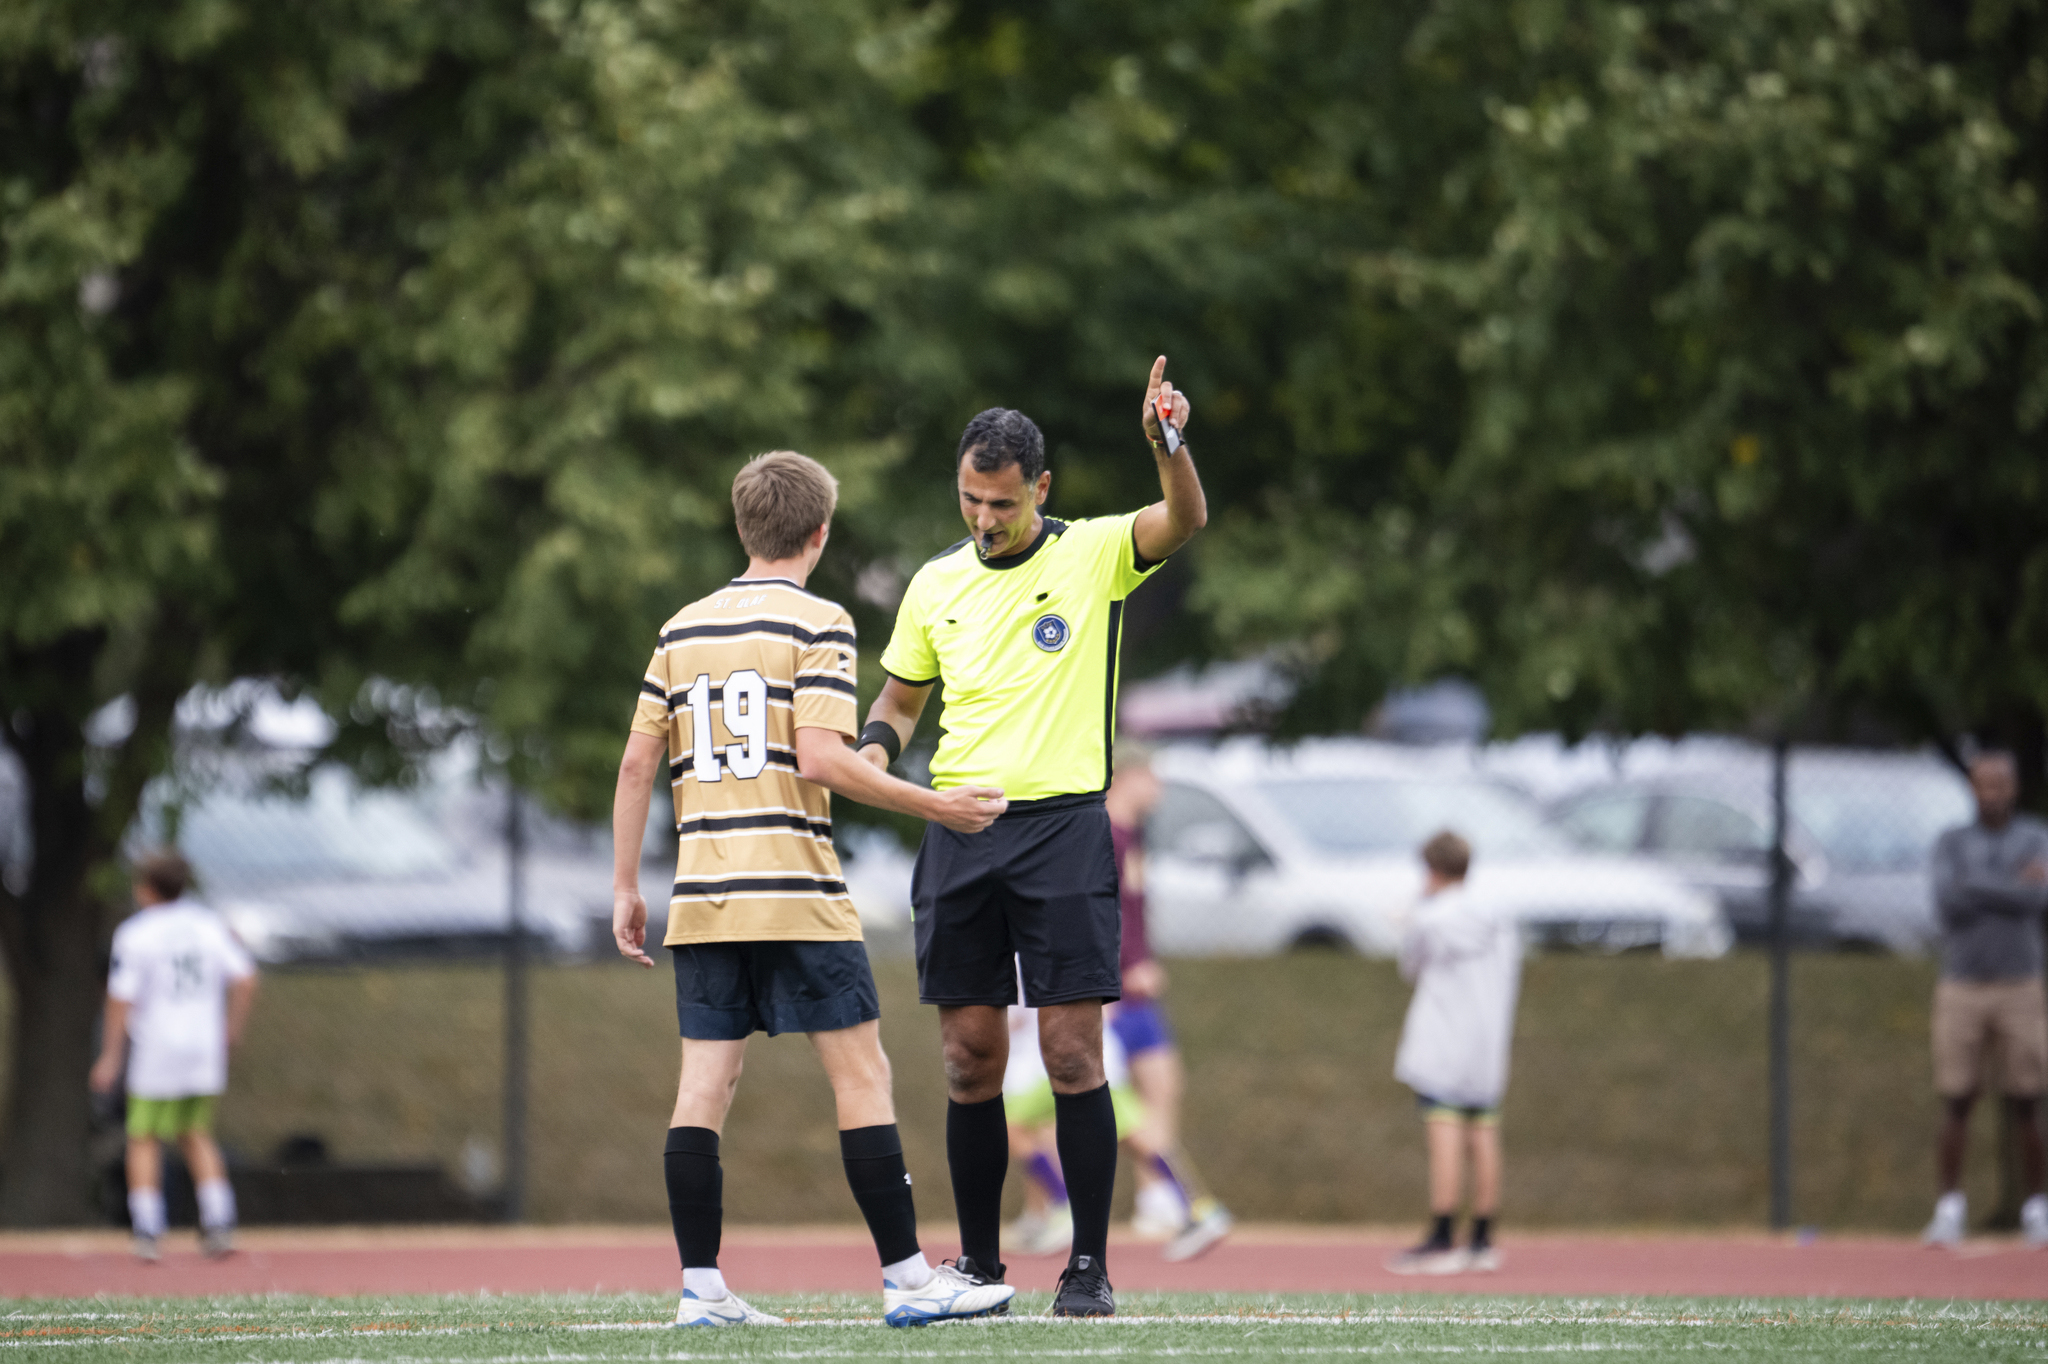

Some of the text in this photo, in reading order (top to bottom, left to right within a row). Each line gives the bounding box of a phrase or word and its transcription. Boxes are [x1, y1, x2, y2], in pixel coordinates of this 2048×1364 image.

[713, 594, 768, 609] ST. OLAF
[687, 669, 767, 782] 19
